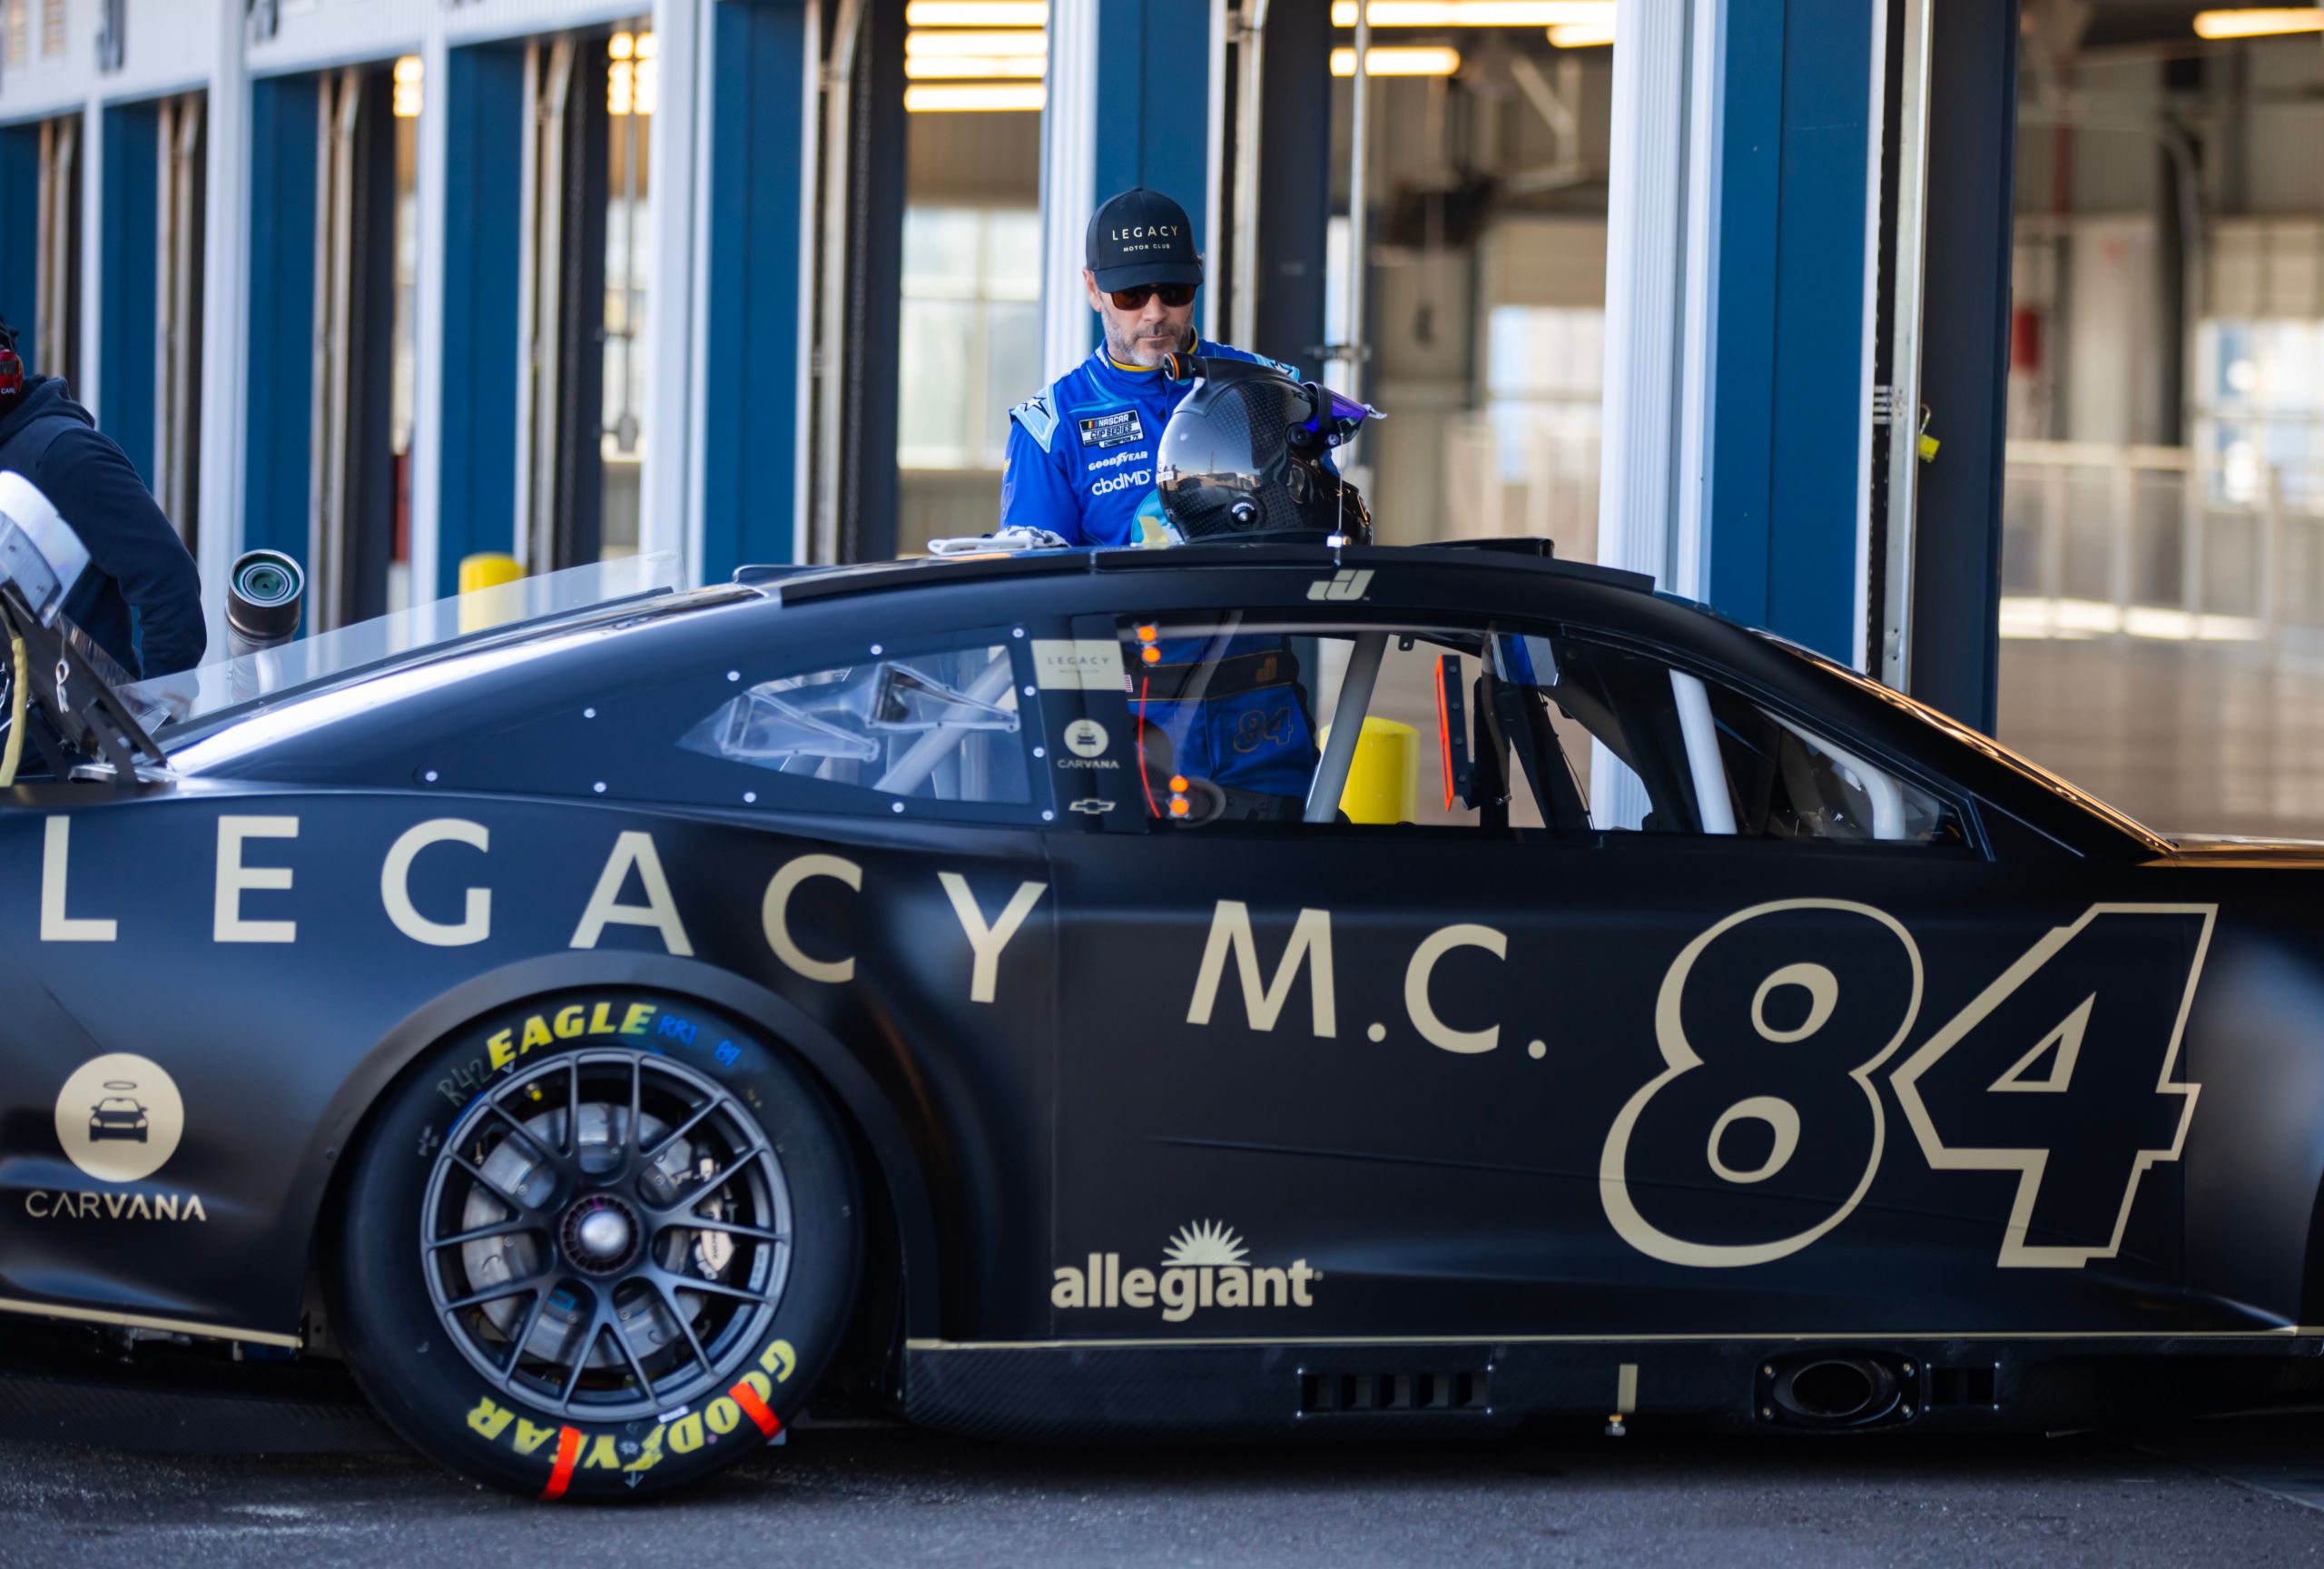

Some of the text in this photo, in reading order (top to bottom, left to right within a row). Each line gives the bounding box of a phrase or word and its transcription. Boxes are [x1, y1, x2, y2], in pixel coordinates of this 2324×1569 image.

[1112, 225, 1177, 241] LEGACY
[1123, 244, 1149, 252] MOTOR
[1090, 423, 1133, 439] CUP SERIES
[1098, 413, 1129, 428] NASCAR
[1088, 451, 1148, 471] GOODYEAR
[1091, 469, 1150, 496] cbdMD
[1047, 656, 1110, 666] LEGACY
[1233, 707, 1294, 753] 84
[1057, 759, 1120, 770] CARVANA
[41, 815, 1546, 1059] LEGACY M.C.
[487, 1002, 657, 1071] EAGLE
[437, 1057, 494, 1109] R42
[1600, 899, 2219, 1268] 84
[25, 1190, 207, 1221] CARVANA
[1050, 1252, 1315, 1323] allegiant
